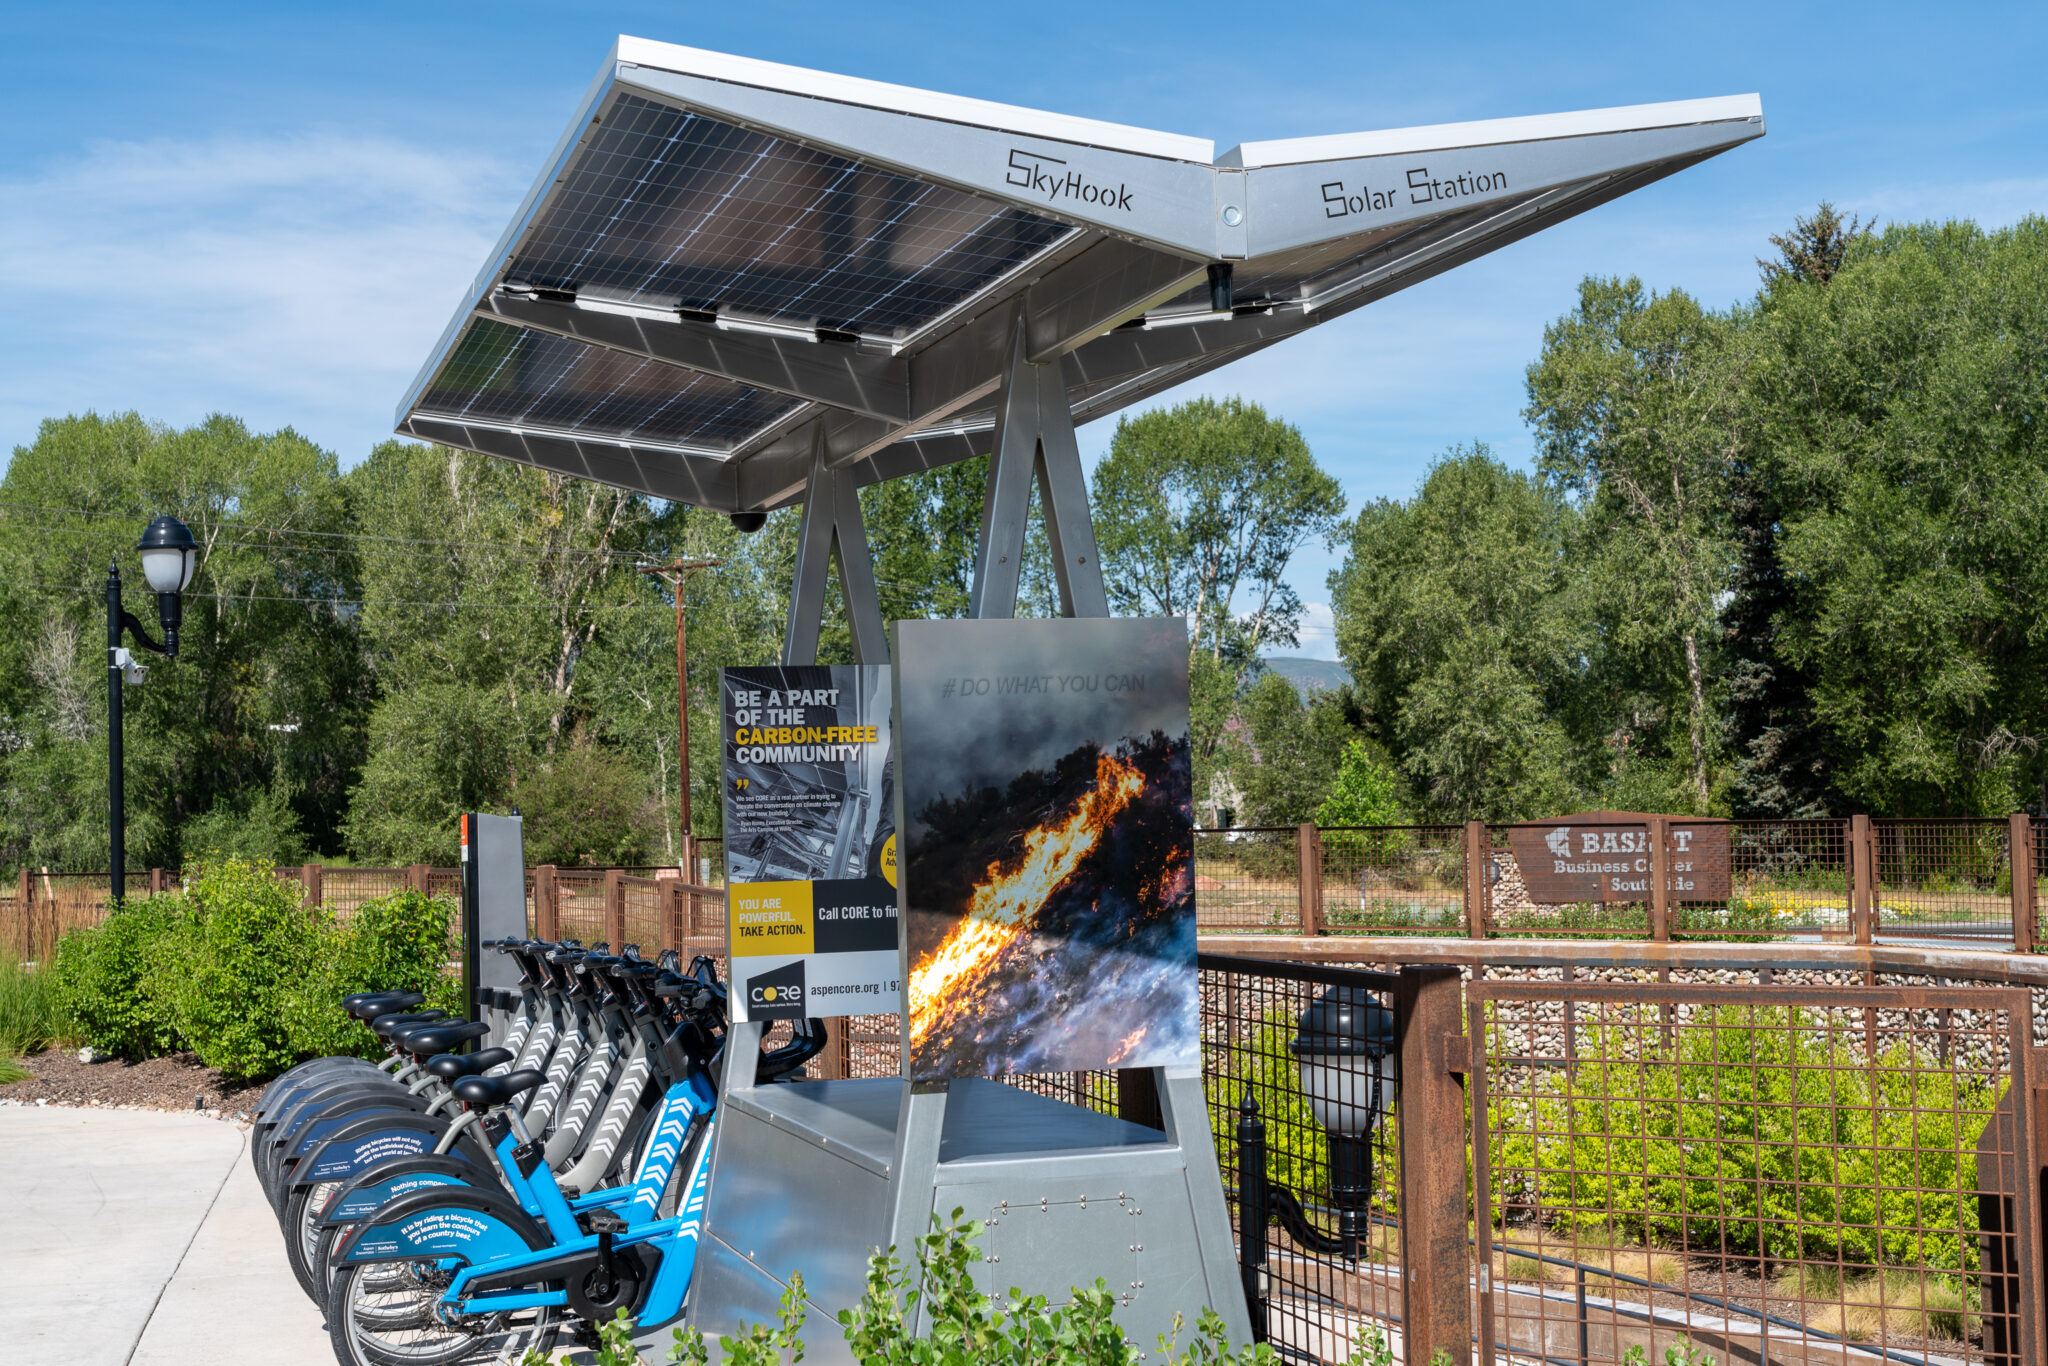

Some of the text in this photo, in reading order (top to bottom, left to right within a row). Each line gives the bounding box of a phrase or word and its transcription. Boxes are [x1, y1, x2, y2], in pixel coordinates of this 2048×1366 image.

[1006, 149, 1133, 211] SkyHook
[1321, 168, 1506, 218] Solar Station
[961, 678, 990, 696] DO
[997, 676, 1053, 694] WHAT
[1058, 674, 1099, 693] YOU
[1105, 674, 1145, 692] CAN
[735, 689, 839, 707] BE A PART
[735, 708, 805, 726] OF THE
[735, 726, 877, 745] CARBON-FREE
[736, 745, 860, 764] COMMUNITY
[1554, 860, 1629, 873] Business
[738, 898, 781, 910] YOU ARE
[739, 912, 796, 923] POWERFUL.
[819, 907, 838, 920] Call
[842, 906, 869, 919] CORE
[872, 906, 882, 918] to
[739, 924, 806, 936] TAKE ACTION.
[811, 983, 879, 996] aspencore.org
[391, 1181, 417, 1193] Nothing
[414, 1220, 423, 1229] by
[424, 1215, 443, 1223] riding
[450, 1214, 473, 1224] bicycle
[474, 1220, 488, 1231] that
[408, 1231, 420, 1241] you
[420, 1224, 438, 1233] learn
[452, 1222, 480, 1236] contours
[414, 1236, 422, 1245] of
[428, 1230, 454, 1239] country
[455, 1231, 471, 1241] best.
